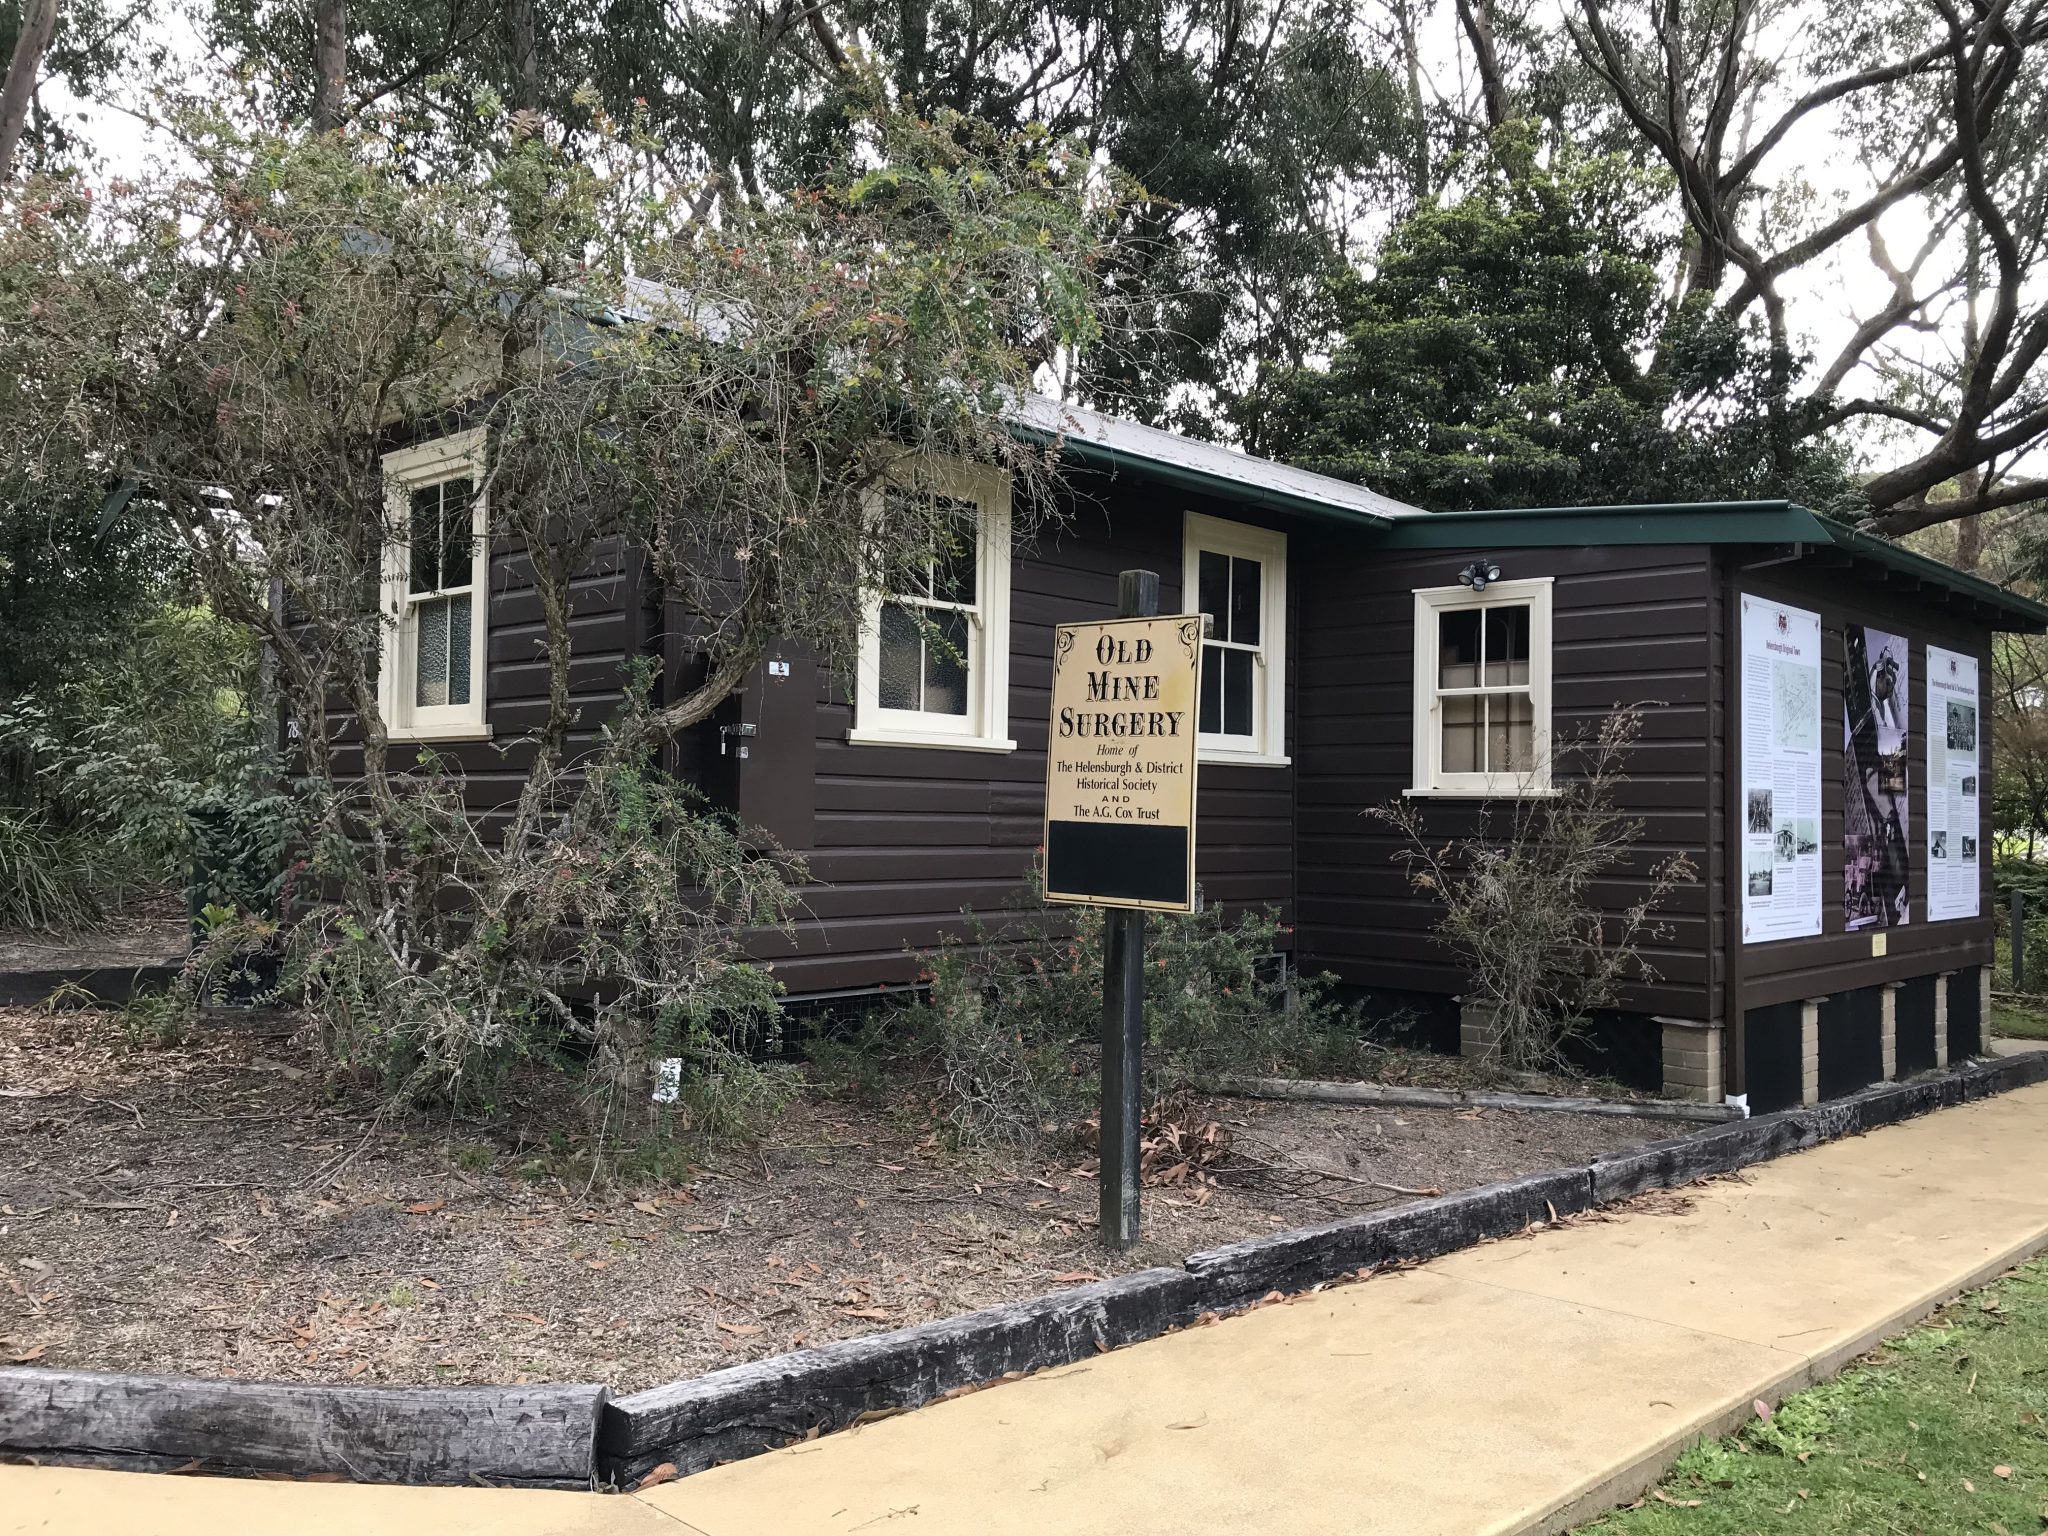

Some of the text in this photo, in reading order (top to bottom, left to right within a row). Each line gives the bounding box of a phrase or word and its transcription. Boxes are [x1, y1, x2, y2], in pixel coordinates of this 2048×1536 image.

[1097, 744, 1140, 758] Home of
[1057, 760, 1183, 776] The Helensburgh & District
[1077, 778, 1157, 794] Historical Society
[1074, 805, 1160, 820] The A.G. Cox Trust
